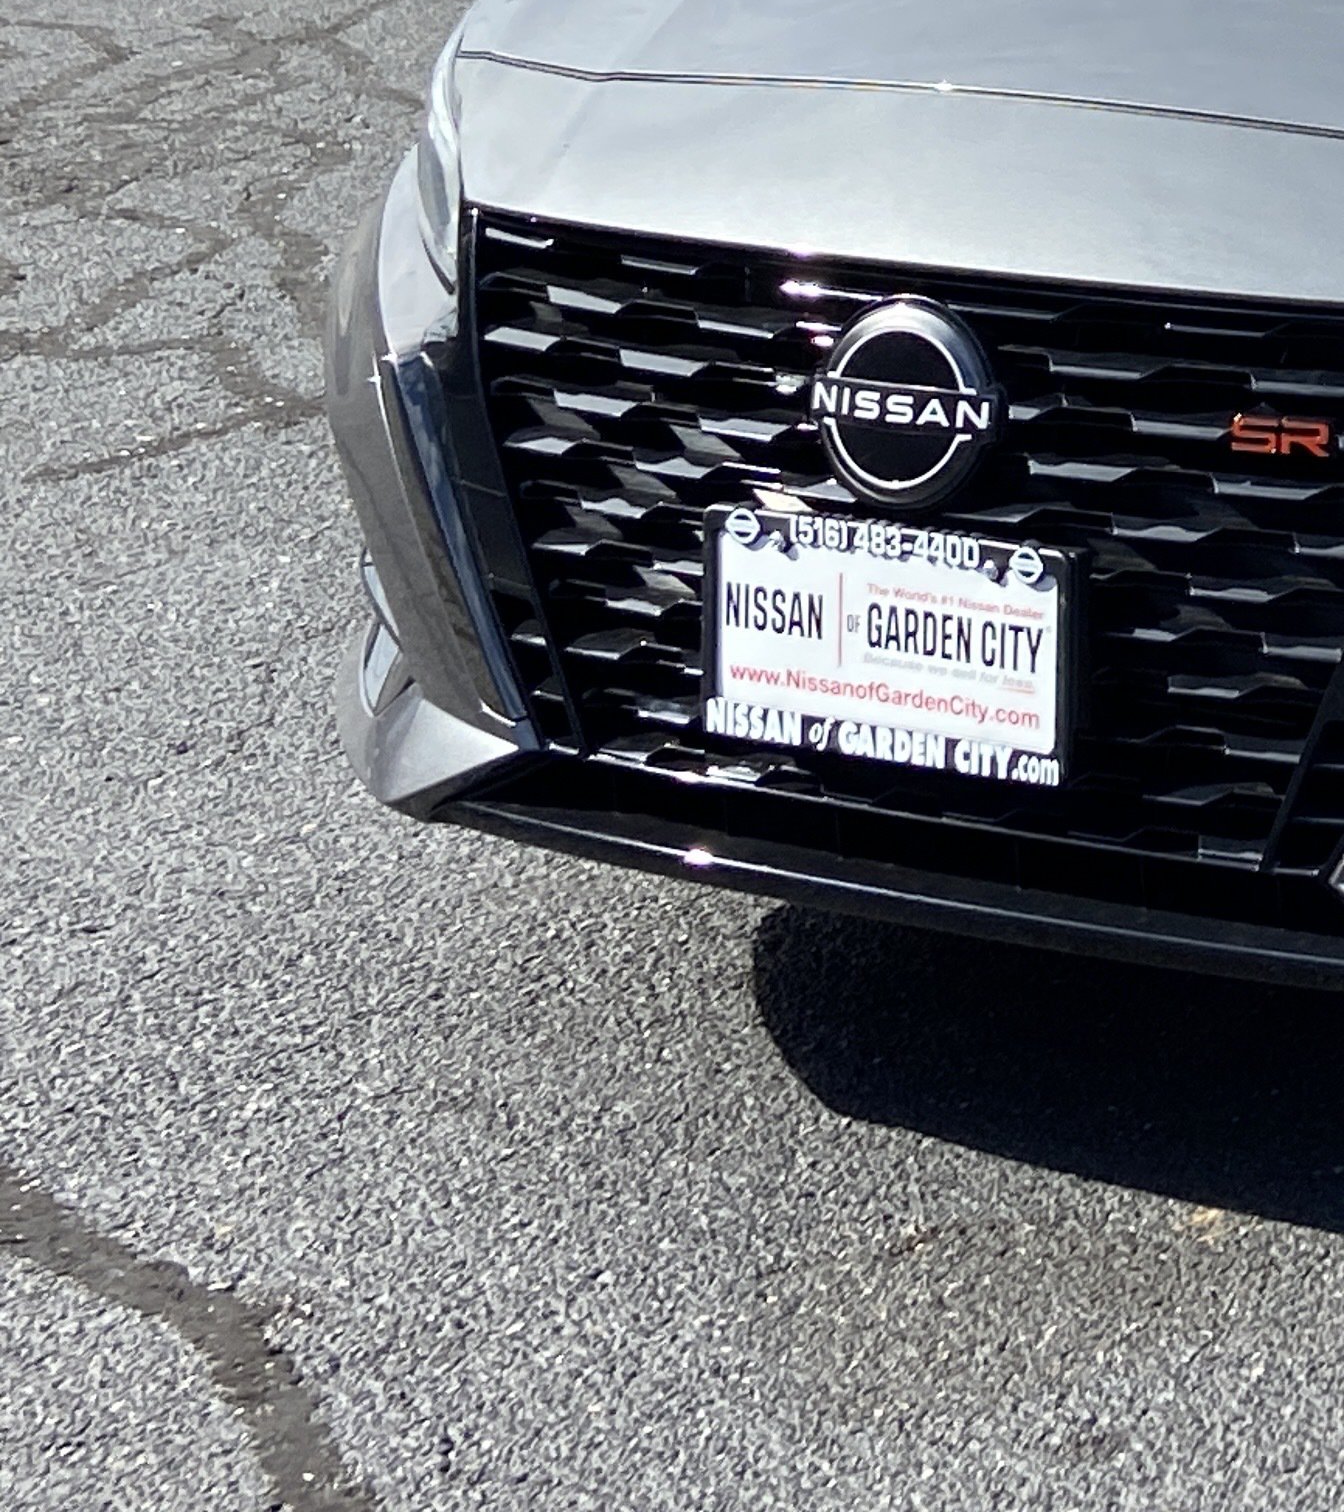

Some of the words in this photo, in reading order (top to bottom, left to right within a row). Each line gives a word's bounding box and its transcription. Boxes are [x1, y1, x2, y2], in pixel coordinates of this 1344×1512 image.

[812, 381, 991, 430] NISSAN
[1231, 412, 1331, 458] SR
[789, 515, 849, 553] (516)
[853, 521, 980, 569] 483-4400
[726, 581, 824, 640] NISSAN
[846, 614, 861, 633] OF
[867, 602, 972, 664] GARDEN
[981, 620, 1044, 674] CITY
[867, 583, 889, 596] The
[893, 588, 938, 605] World's
[958, 597, 1000, 614] Nissan
[1003, 603, 1045, 620] Dealer
[730, 663, 1041, 730] www.NissanofGardenCity.com
[705, 696, 802, 746] NISSAN
[808, 717, 836, 752] of
[838, 721, 947, 769] GARDEN
